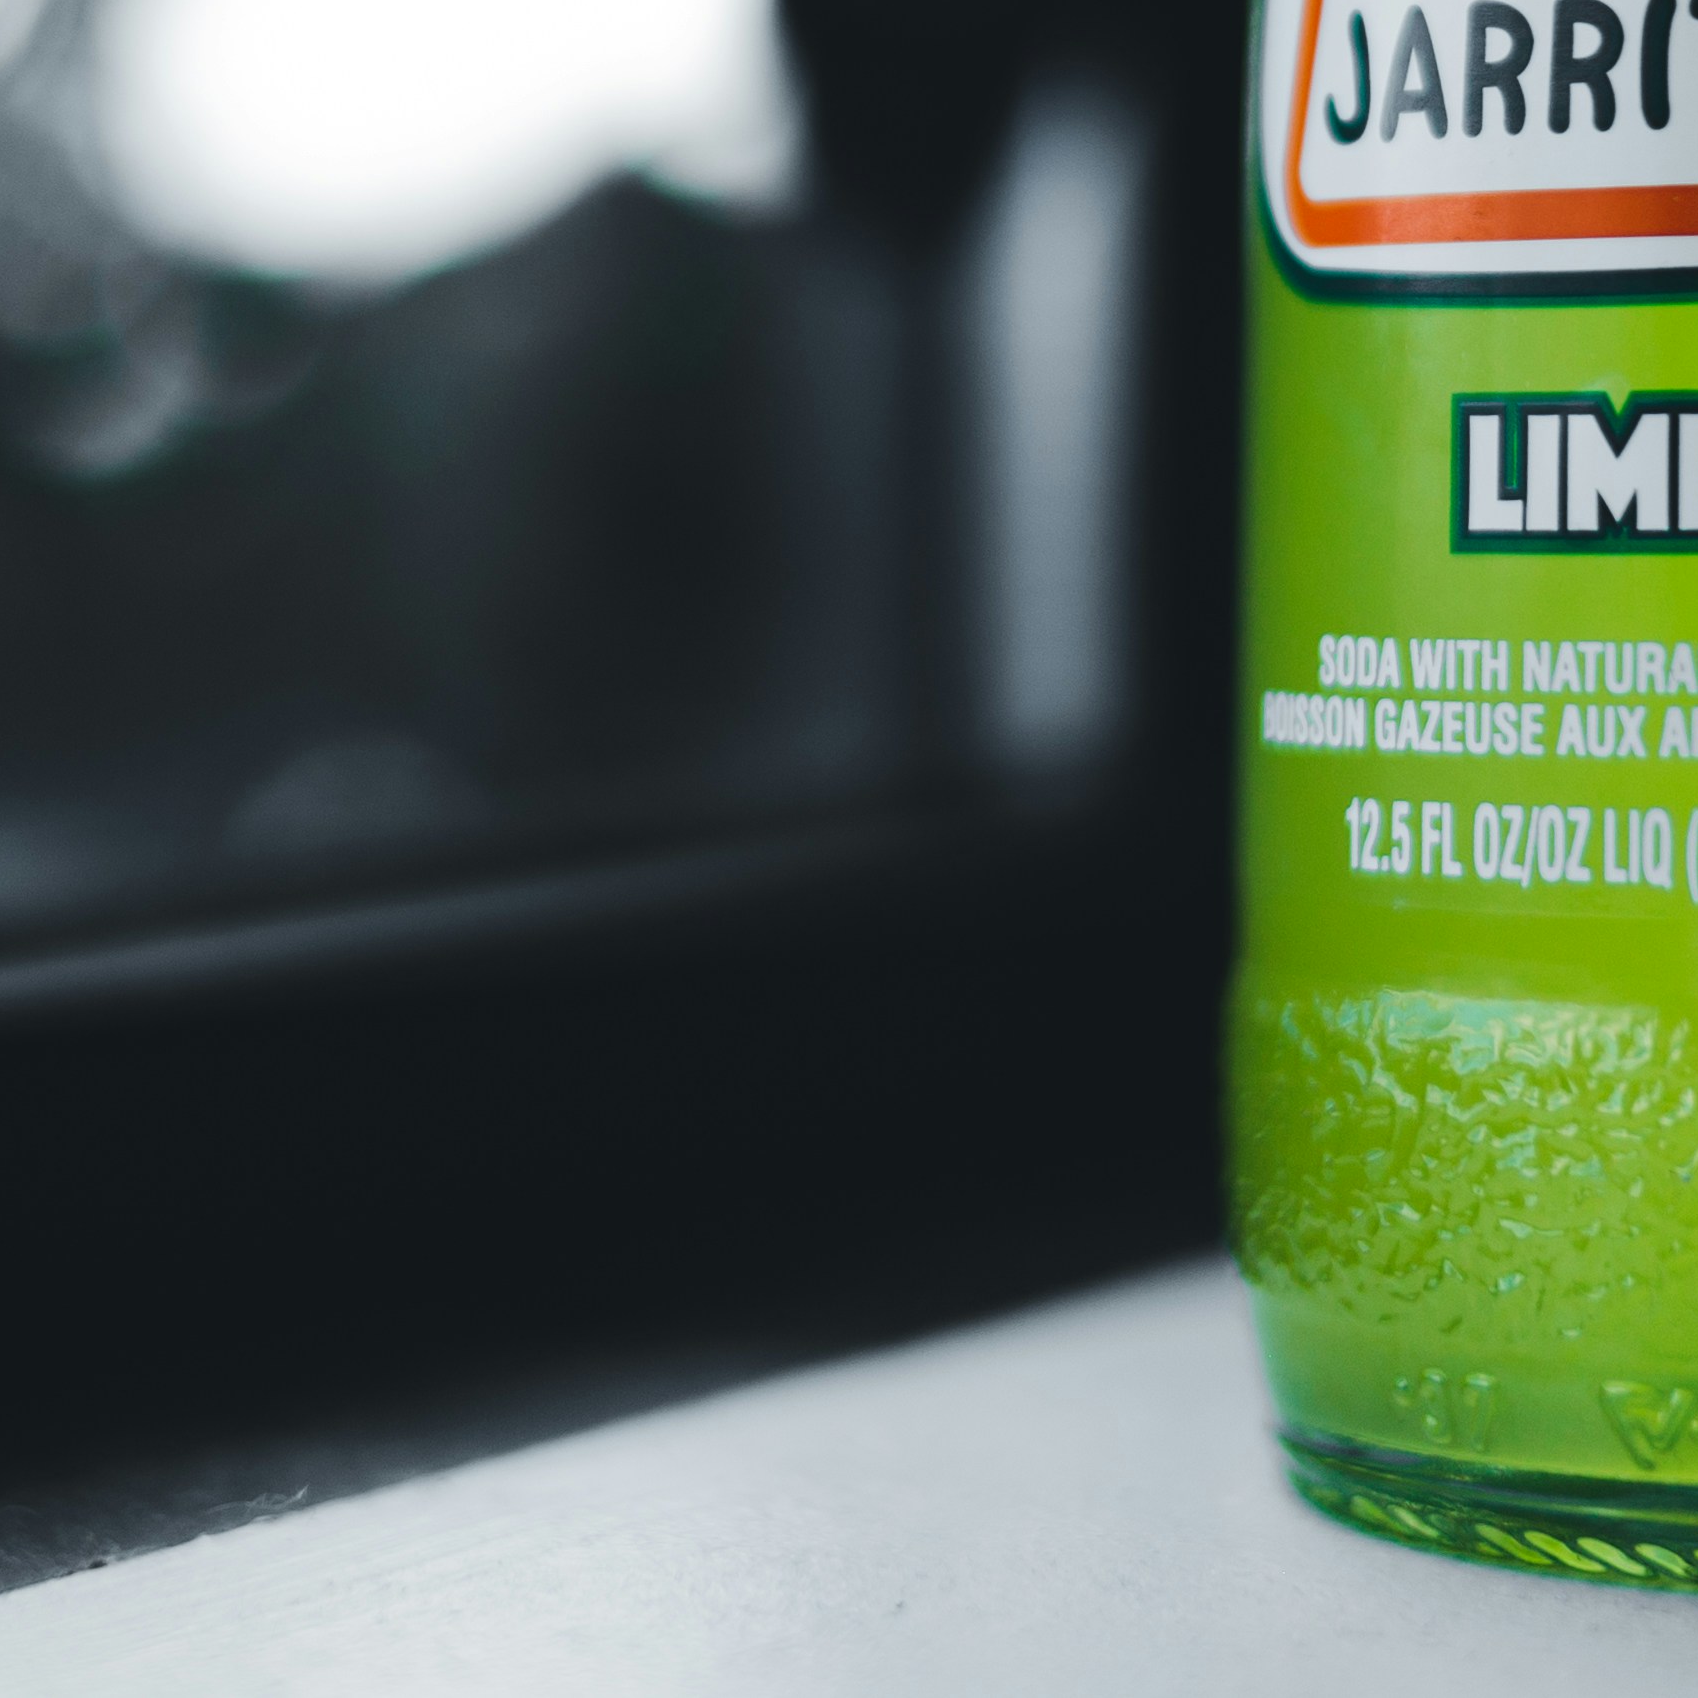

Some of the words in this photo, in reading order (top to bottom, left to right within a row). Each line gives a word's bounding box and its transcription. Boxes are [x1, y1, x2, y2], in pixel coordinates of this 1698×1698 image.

[1318, 634, 1401, 689] SODA
[1409, 637, 1509, 691] WITH
[1374, 698, 1545, 755] GAZEUSE
[1556, 704, 1647, 758] AUX
[1345, 797, 1412, 874] 12.5
[1420, 800, 1463, 877] FL
[1472, 802, 1592, 889] OZ/OZ
[1603, 807, 1673, 890] LIQ
